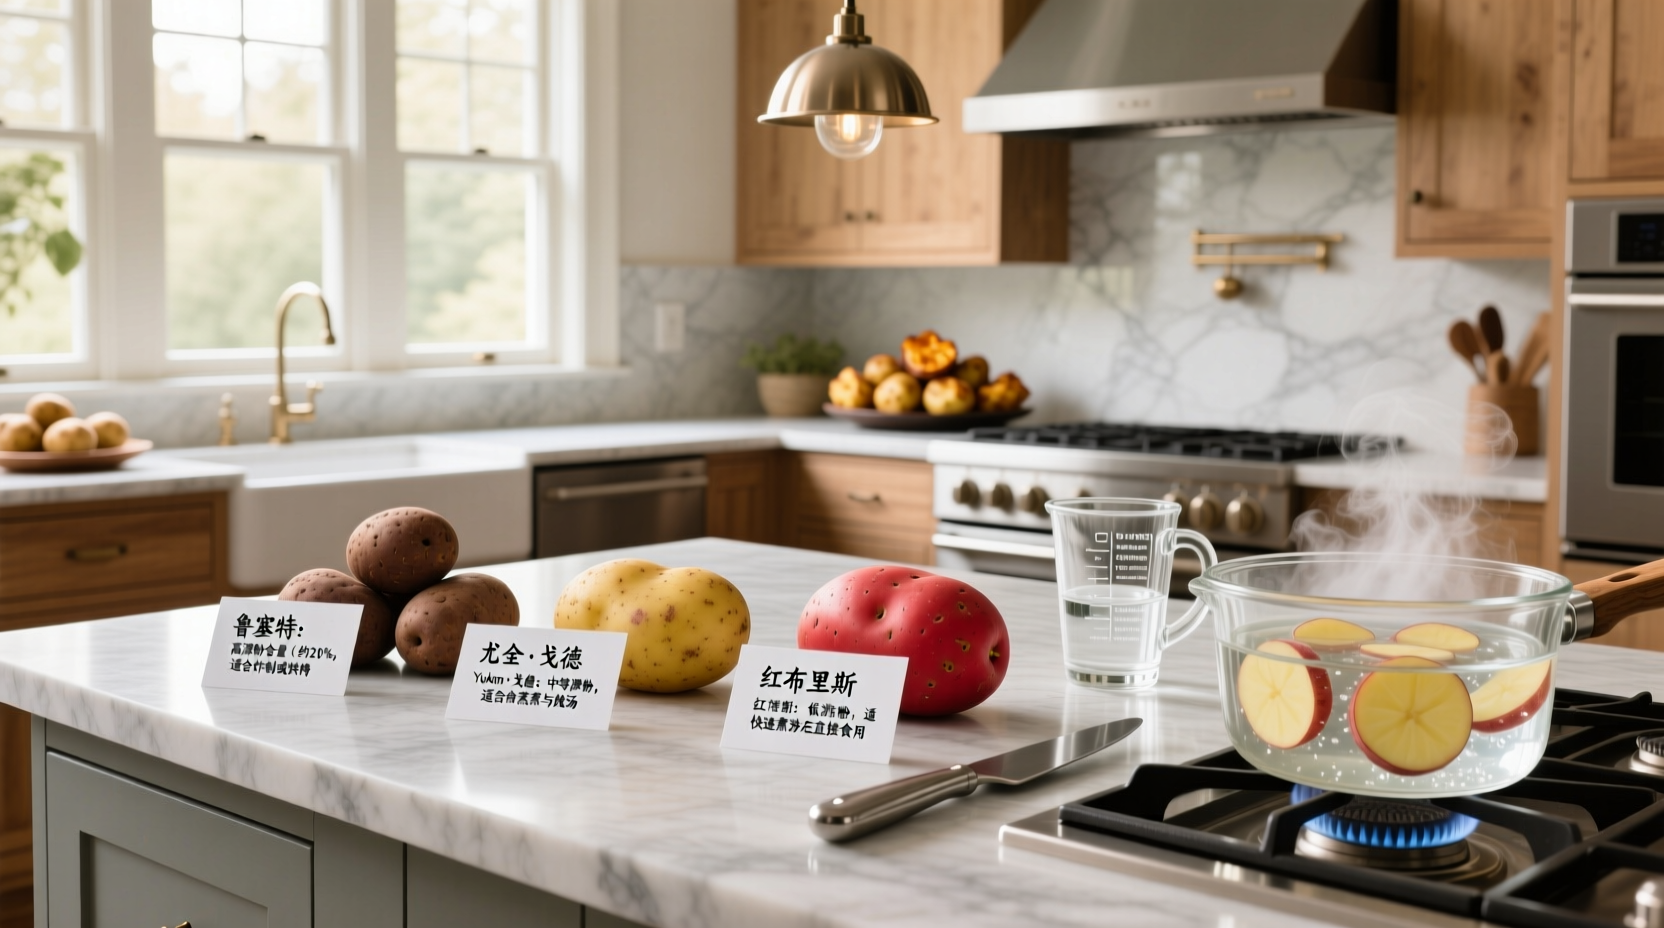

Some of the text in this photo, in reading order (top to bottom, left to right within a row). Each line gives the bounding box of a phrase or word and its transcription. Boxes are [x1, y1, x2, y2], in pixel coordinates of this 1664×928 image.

[233, 612, 304, 640] 鲁塞特：
[479, 641, 583, 670] 尤全·戈德
[759, 665, 858, 698] 红布里斯
